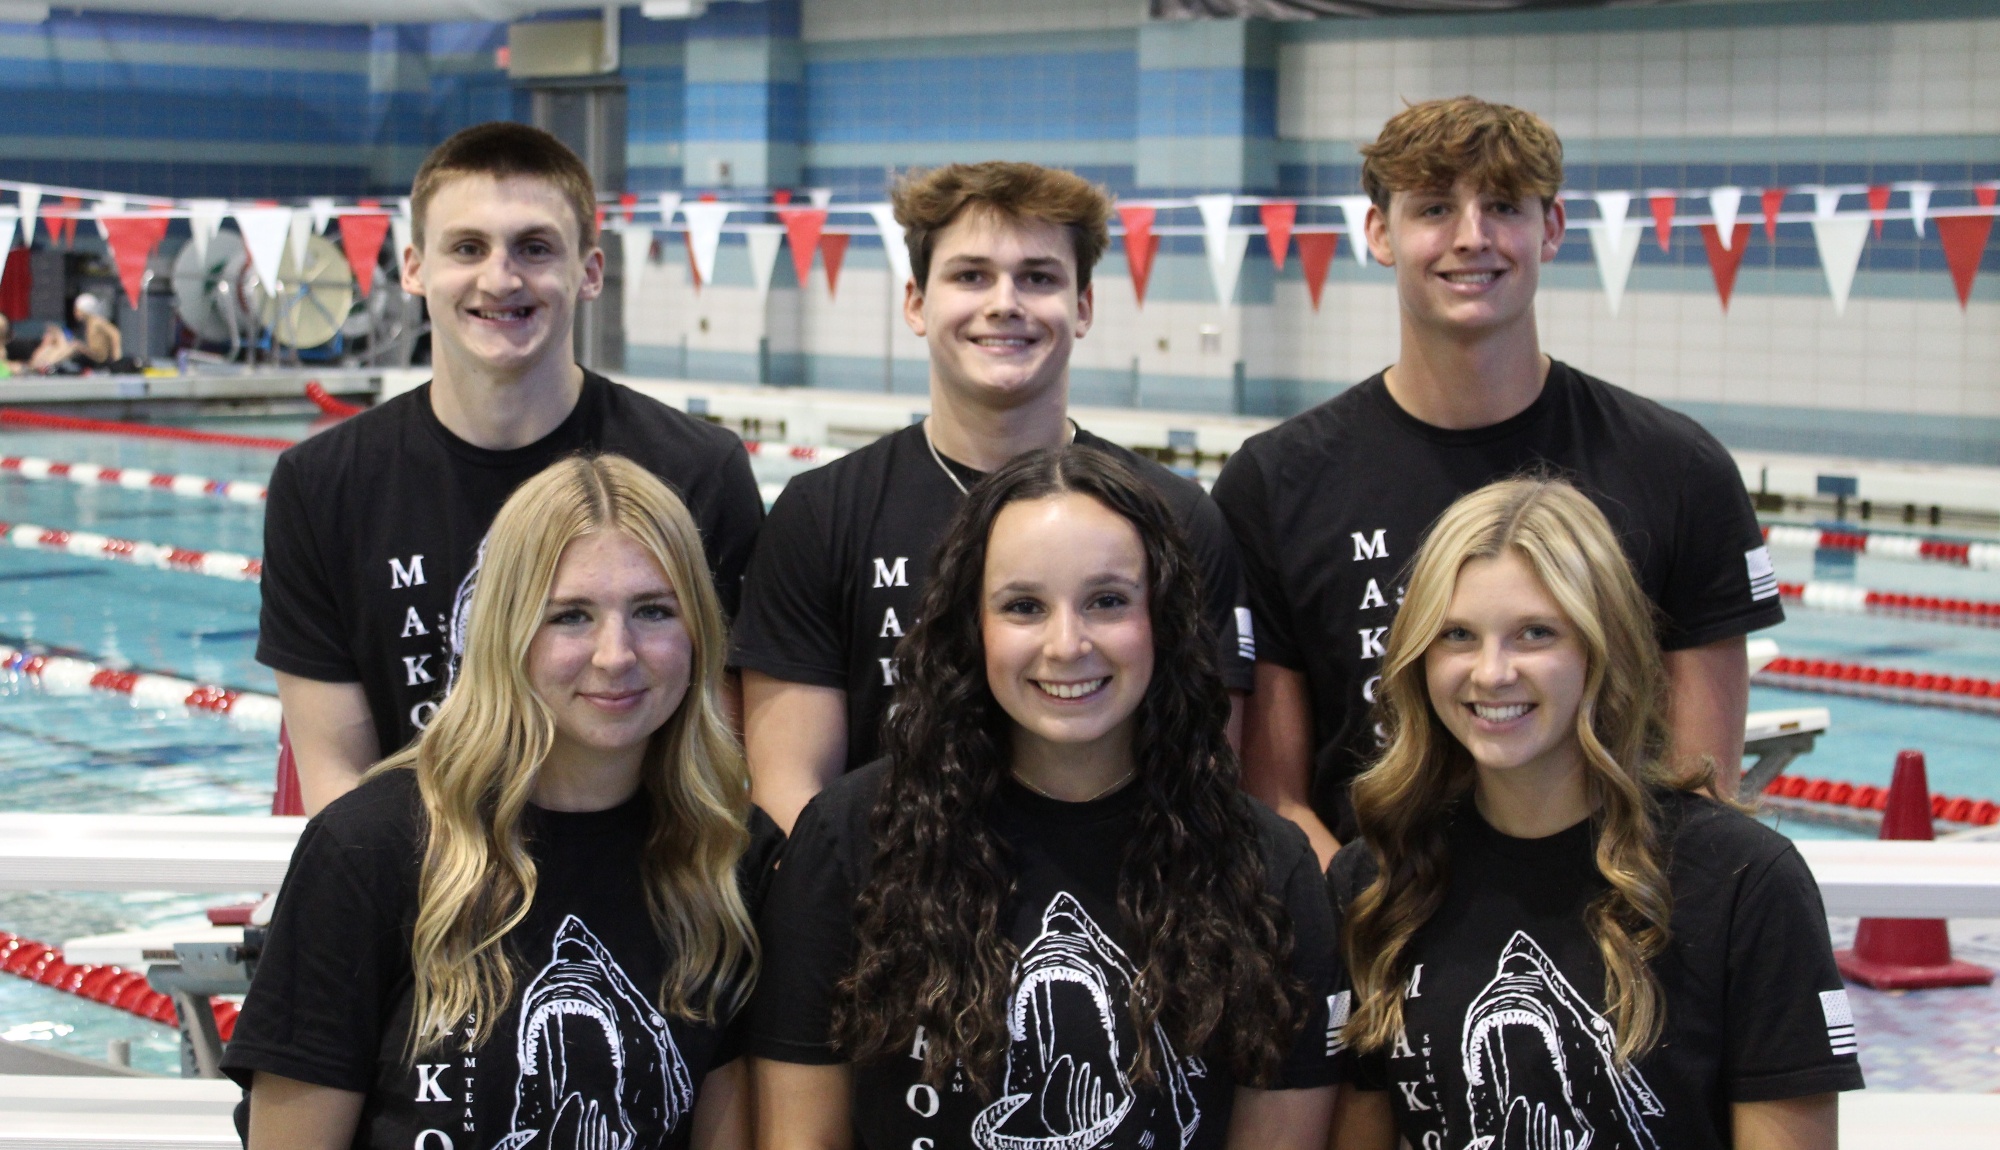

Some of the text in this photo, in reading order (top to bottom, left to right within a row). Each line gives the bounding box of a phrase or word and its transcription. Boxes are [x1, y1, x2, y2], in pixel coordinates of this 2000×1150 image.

[872, 556, 909, 721] MAK
[463, 1013, 476, 1132] SWIM TEAM
[1421, 1033, 1436, 1084] SWIM
